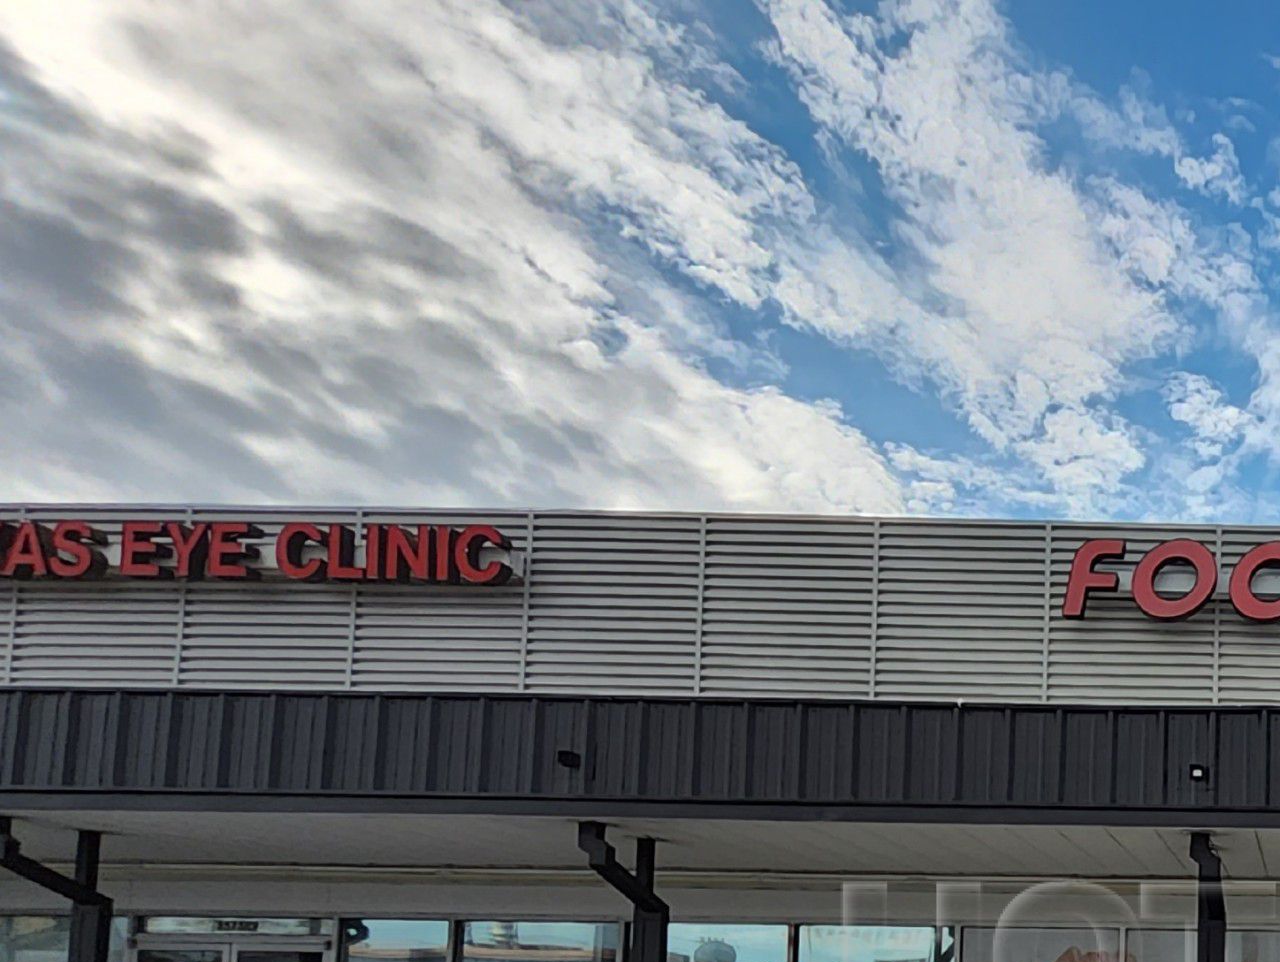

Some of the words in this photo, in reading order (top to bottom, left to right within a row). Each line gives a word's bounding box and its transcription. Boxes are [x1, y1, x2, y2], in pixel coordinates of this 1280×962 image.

[0, 520, 93, 577] AS
[119, 521, 249, 578] EYE
[275, 523, 504, 583] CLINIC
